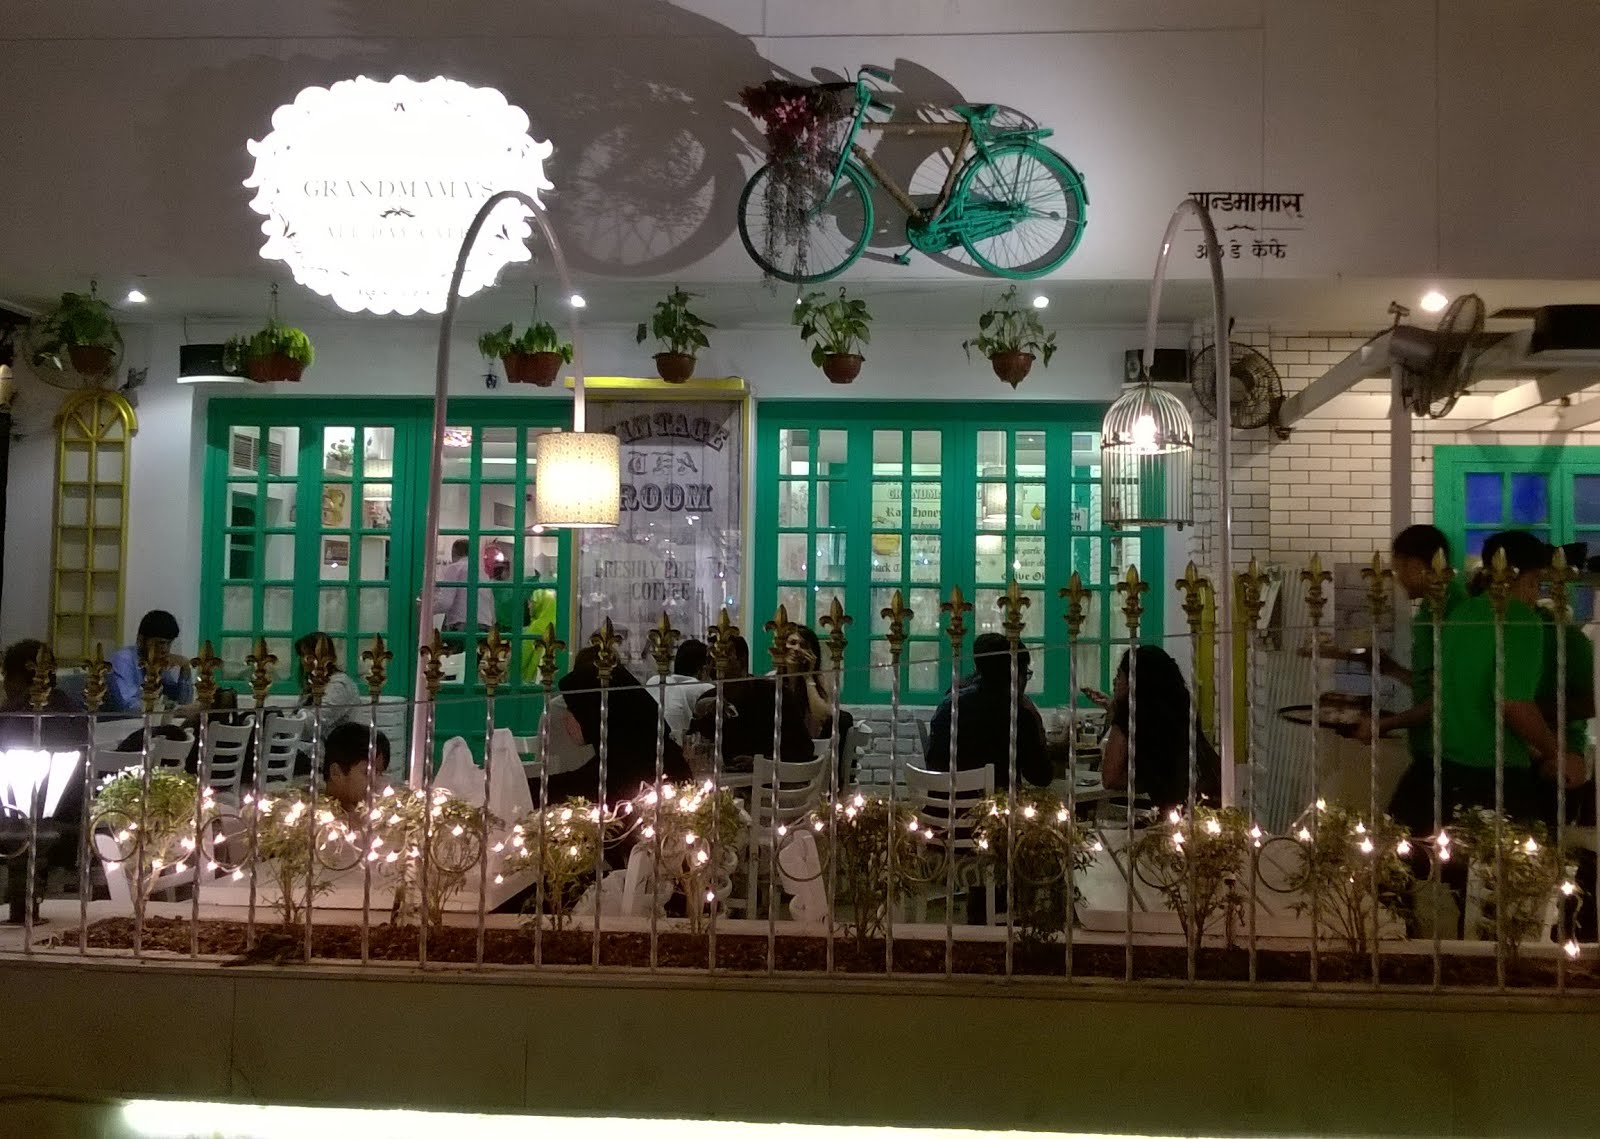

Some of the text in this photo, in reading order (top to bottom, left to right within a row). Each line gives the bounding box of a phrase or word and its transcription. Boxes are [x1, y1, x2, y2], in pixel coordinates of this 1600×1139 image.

[303, 180, 493, 199] GRANDMAMA'S
[627, 450, 698, 476] TEA
[620, 482, 713, 513] ROOM
